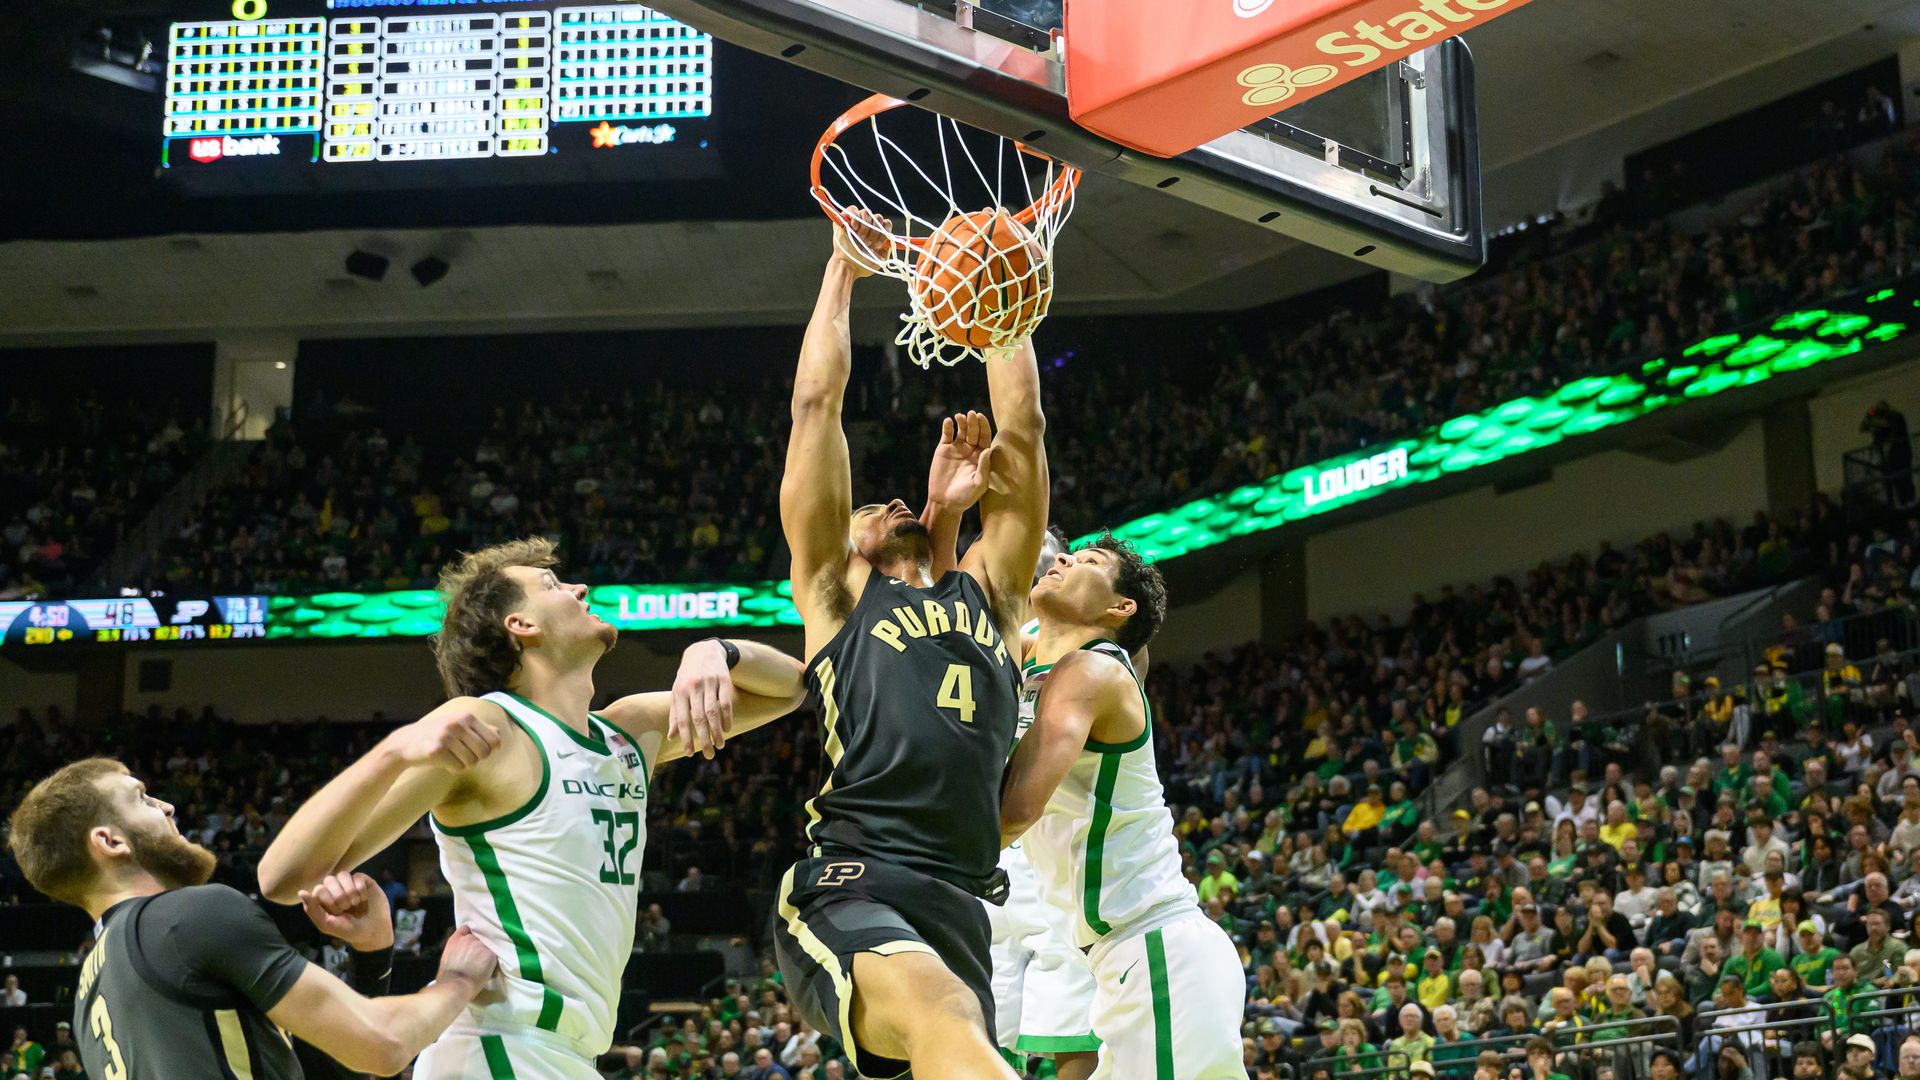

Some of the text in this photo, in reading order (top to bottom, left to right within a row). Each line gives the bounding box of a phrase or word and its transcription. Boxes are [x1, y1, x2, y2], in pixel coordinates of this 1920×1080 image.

[1304, 447, 1408, 506] LOUDER
[620, 591, 739, 620] LOUDER
[936, 663, 976, 723] 4
[562, 779, 645, 799] DUCKS
[591, 808, 639, 885] 32
[816, 861, 865, 887] P
[90, 994, 128, 1080] 3
